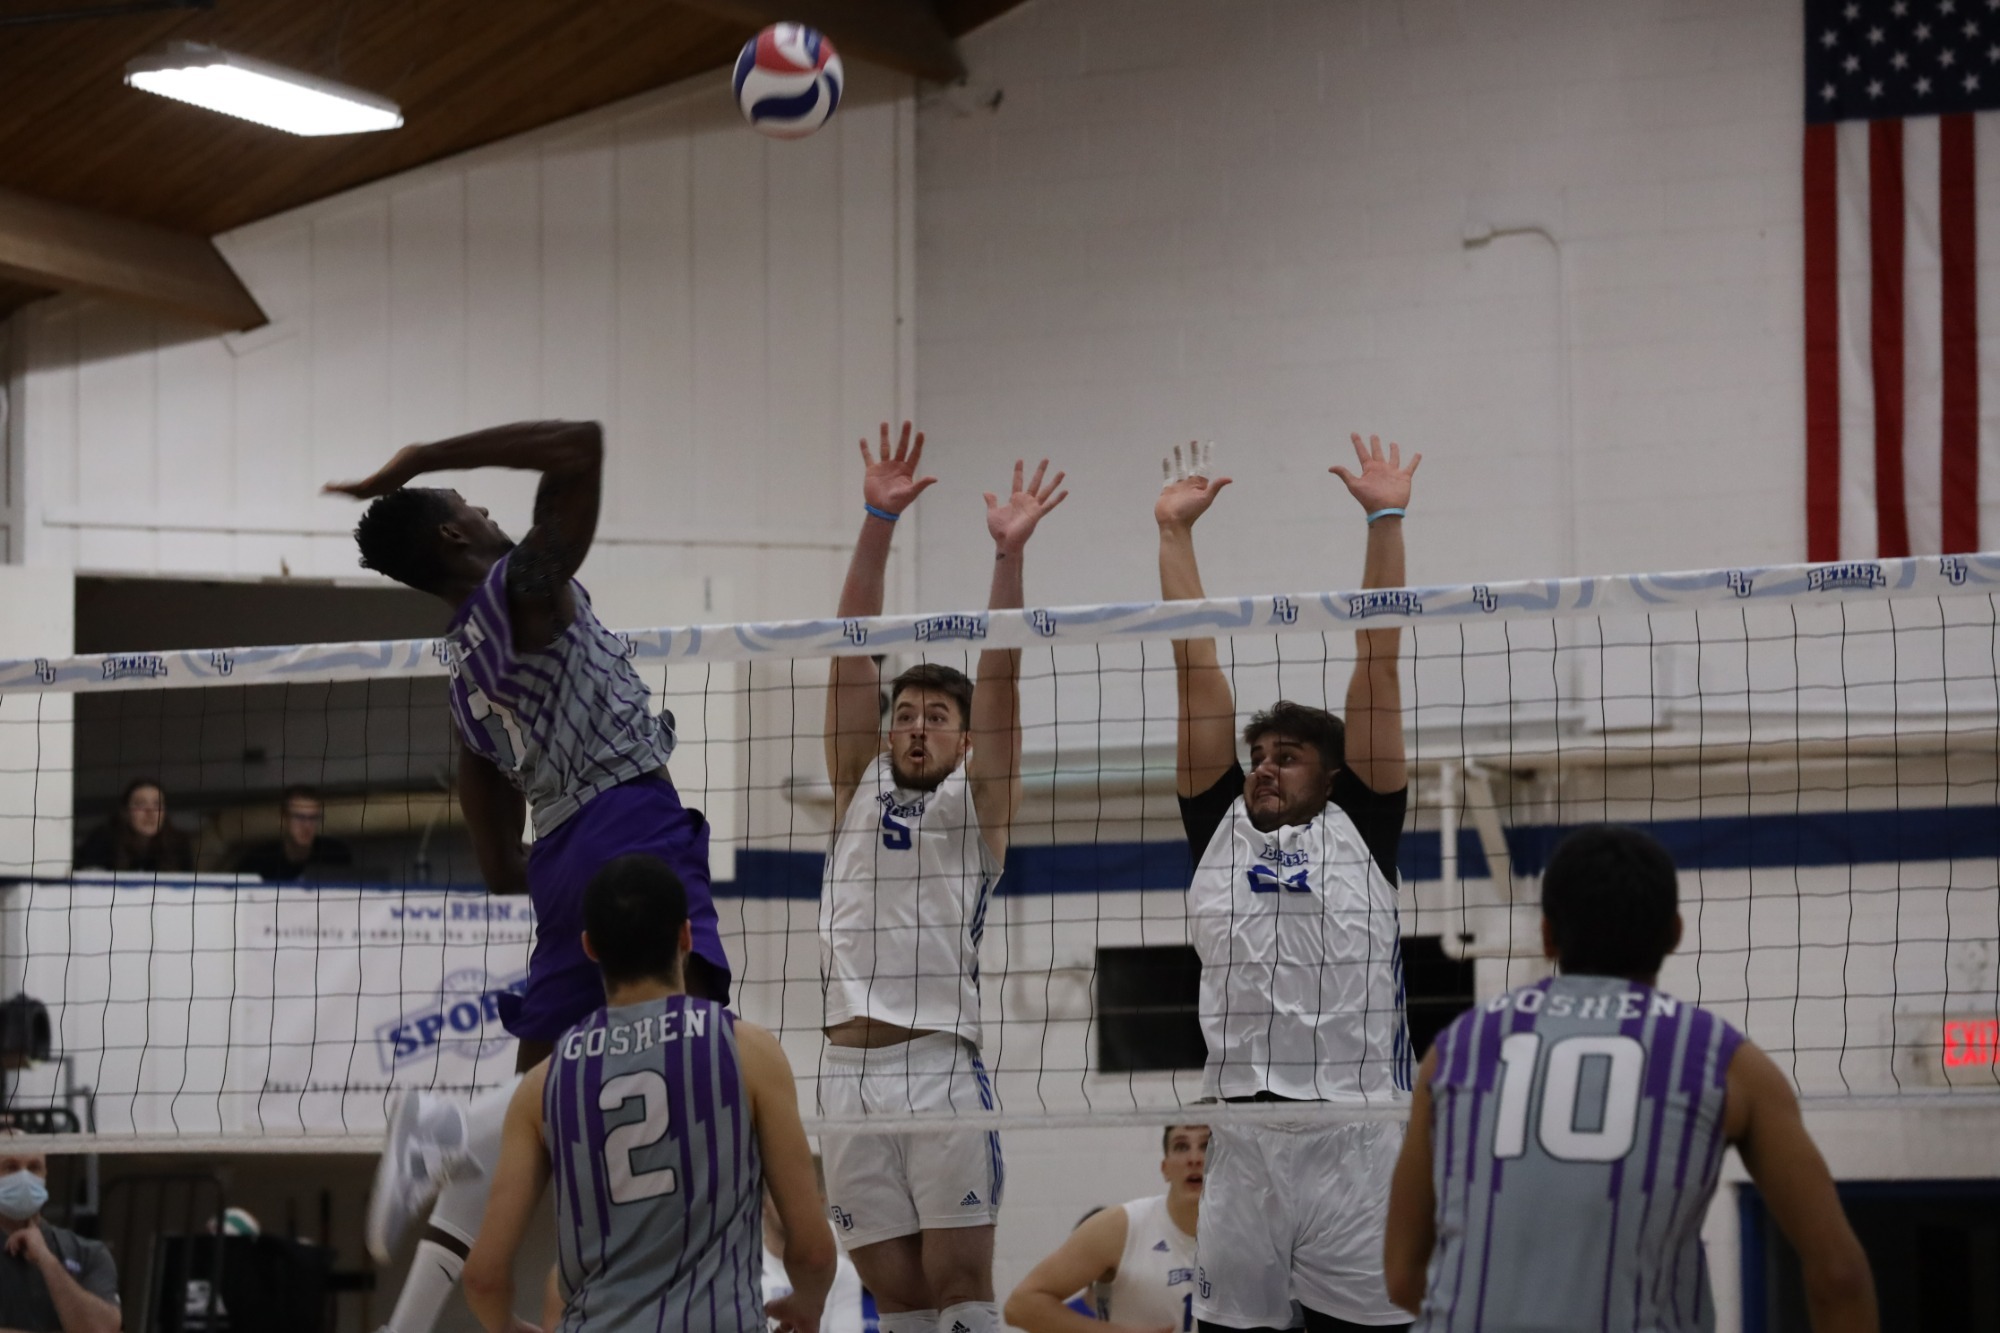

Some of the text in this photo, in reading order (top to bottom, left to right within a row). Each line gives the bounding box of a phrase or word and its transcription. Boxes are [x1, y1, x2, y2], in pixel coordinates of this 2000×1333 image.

[1728, 570, 1752, 598] BU
[1807, 563, 1886, 592] BETHEL
[1941, 558, 1967, 585] BU
[1273, 597, 1298, 624] BU
[1350, 591, 1422, 618] BETHEL
[1473, 586, 1498, 613] BU
[844, 620, 867, 646] BU
[915, 615, 986, 641] BETHEL
[1034, 610, 1055, 637] BU
[102, 656, 168, 680] BETHEL
[211, 652, 234, 676] BU
[882, 808, 912, 850] 5
[1259, 843, 1309, 868] BHEL
[563, 1009, 707, 1061] GOSHEN
[1492, 1031, 1647, 1164] 10
[598, 1068, 678, 1206] 2
